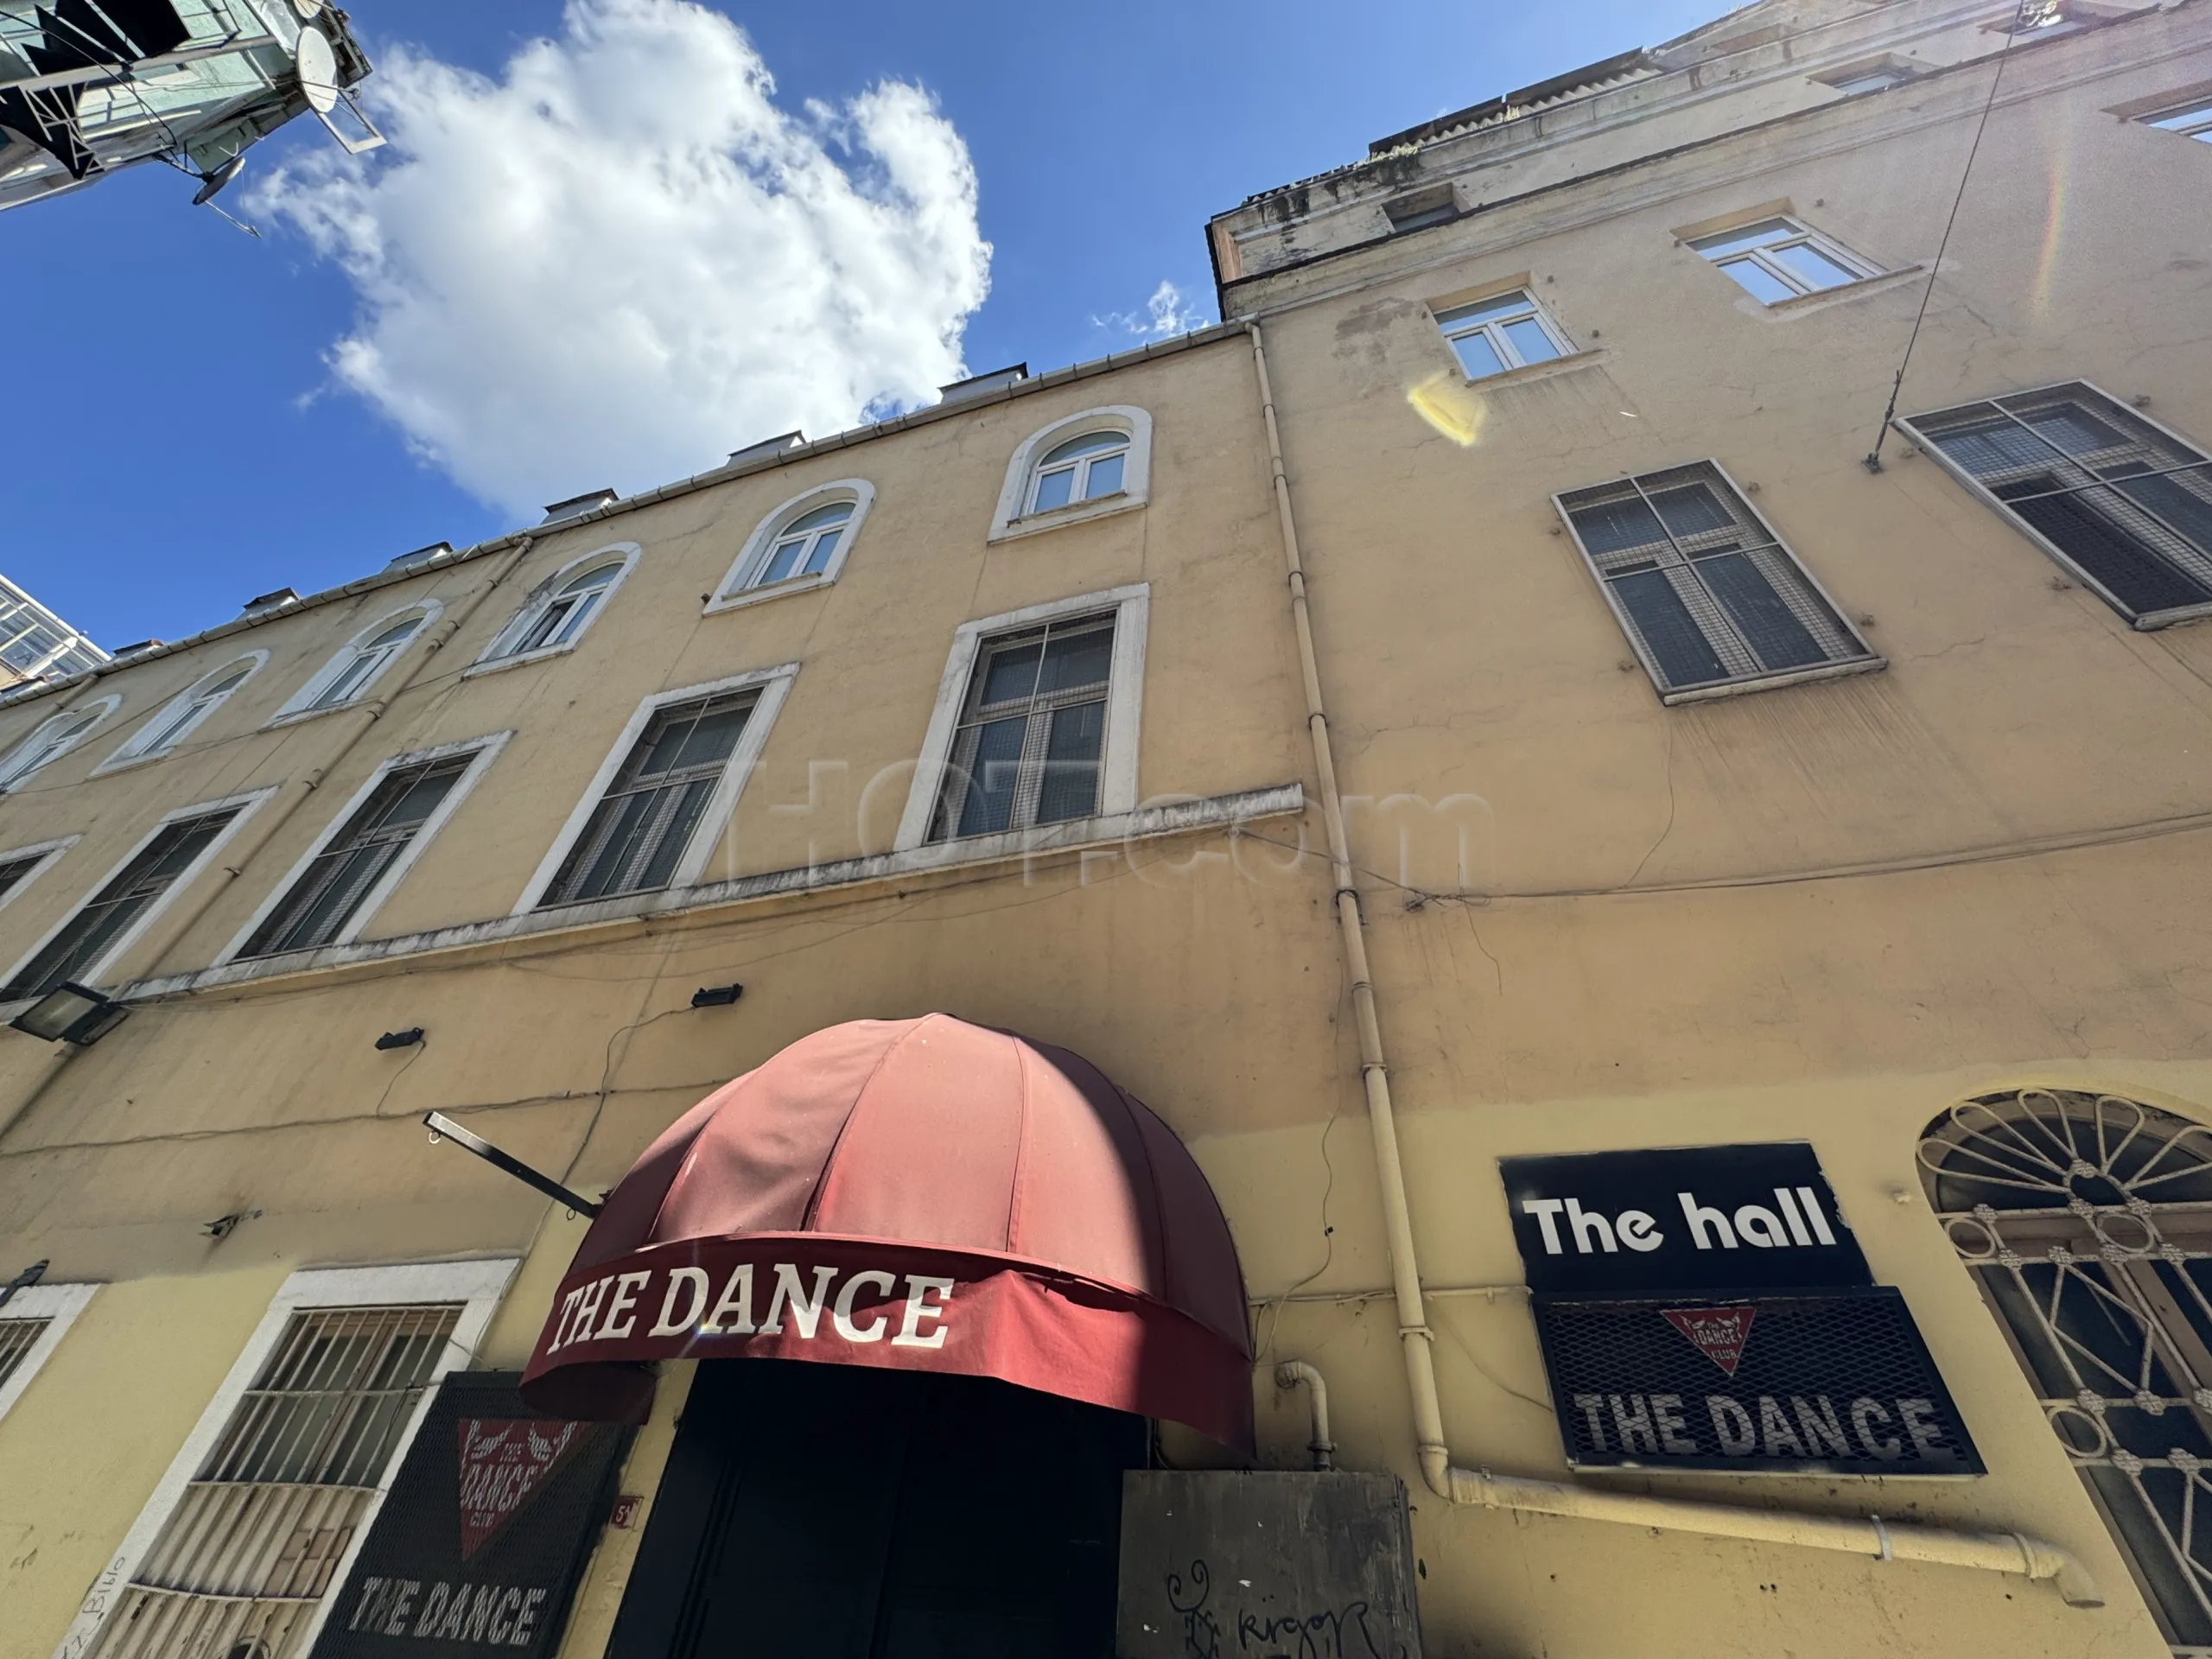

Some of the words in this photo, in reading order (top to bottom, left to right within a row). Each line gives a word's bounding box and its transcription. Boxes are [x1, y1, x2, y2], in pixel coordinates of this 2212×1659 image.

[1522, 1198, 1664, 1255] The
[1677, 1186, 1837, 1249] hall
[545, 1269, 652, 1356] THE
[650, 1262, 955, 1350] DANCE
[1697, 1328, 1737, 1345] DANCE
[1573, 1393, 1698, 1454] THE
[1706, 1393, 1954, 1460] DANCE
[348, 1576, 421, 1636] THE
[413, 1581, 547, 1645] DANCE
